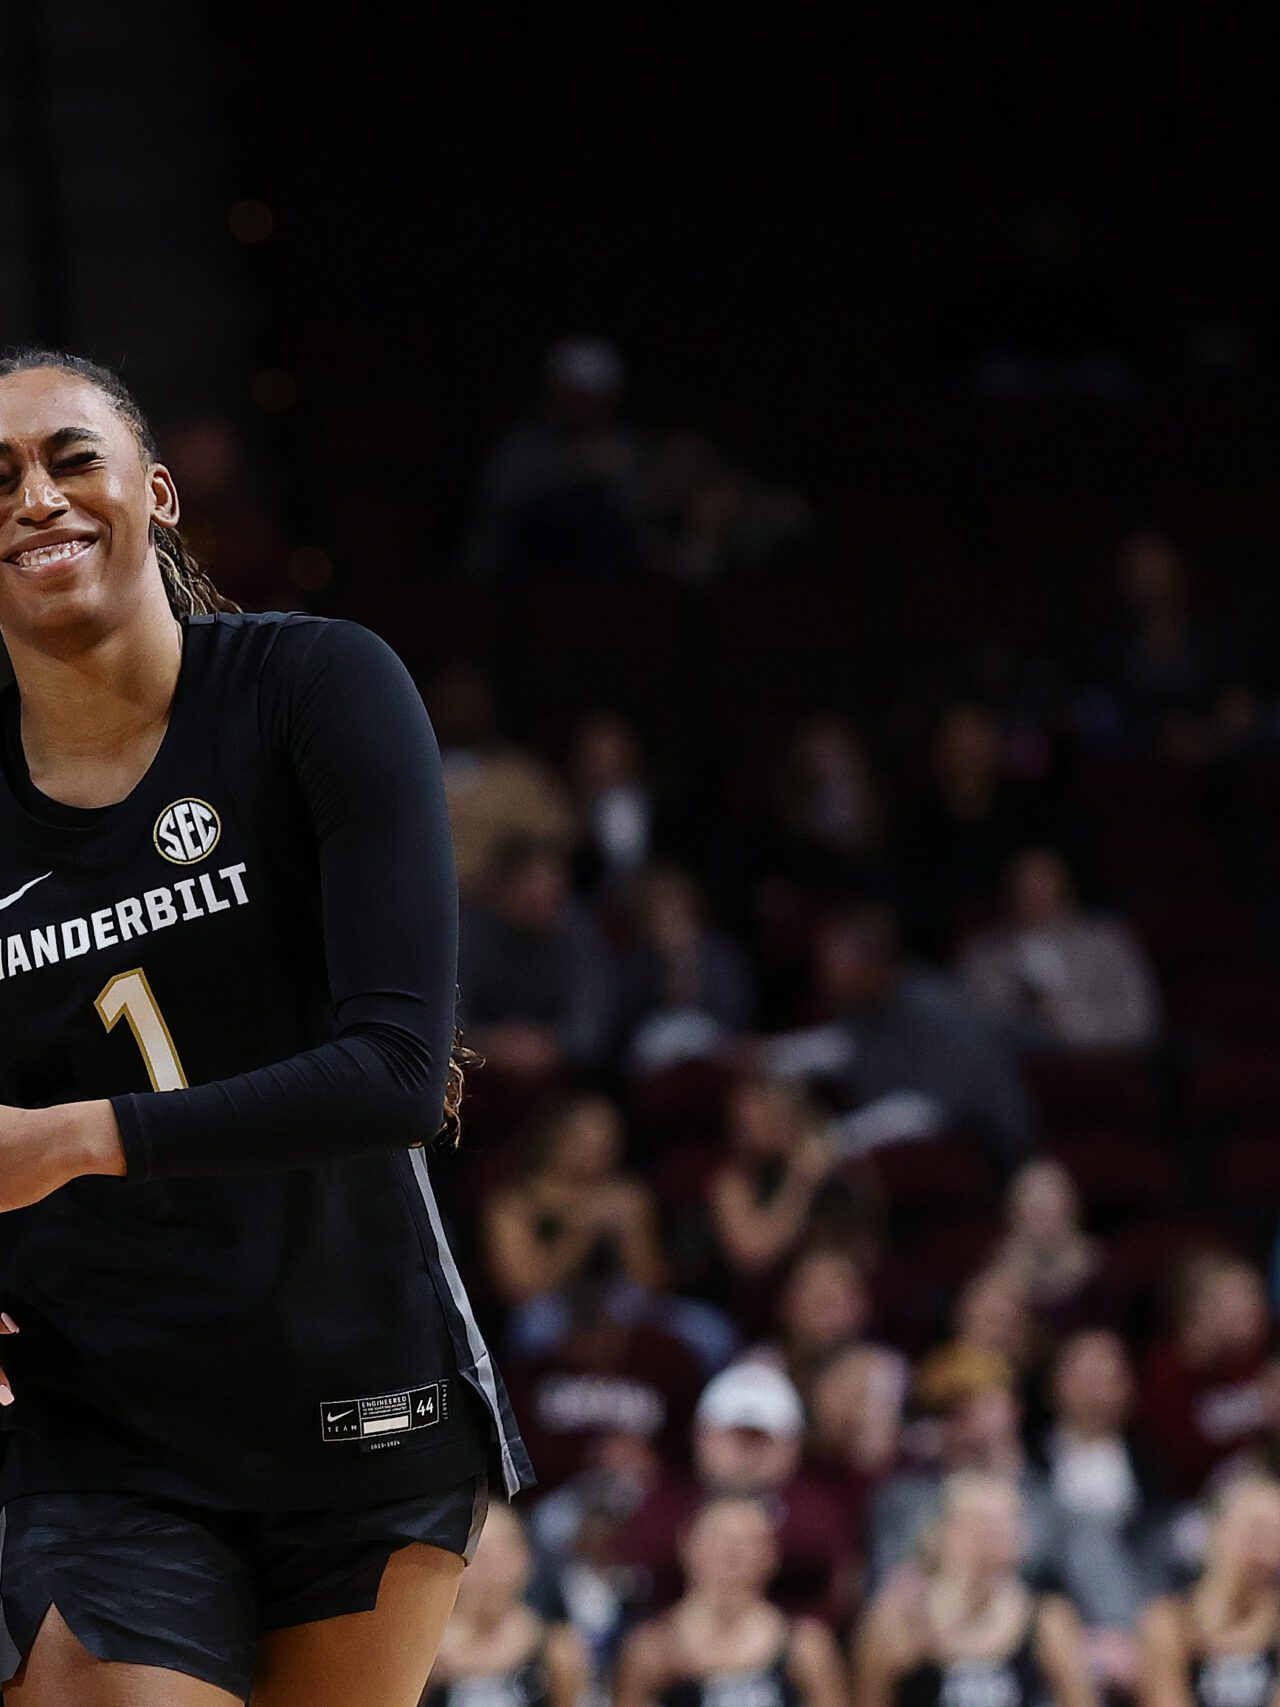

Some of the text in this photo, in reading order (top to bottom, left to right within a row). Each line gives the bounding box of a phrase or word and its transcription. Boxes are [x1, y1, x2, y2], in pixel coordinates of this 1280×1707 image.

[158, 801, 217, 861] SEC
[93, 967, 190, 1092] 1
[361, 1396, 407, 1408] ENGINEERED
[416, 1396, 434, 1417] 44
[327, 1424, 357, 1433] TEAM
